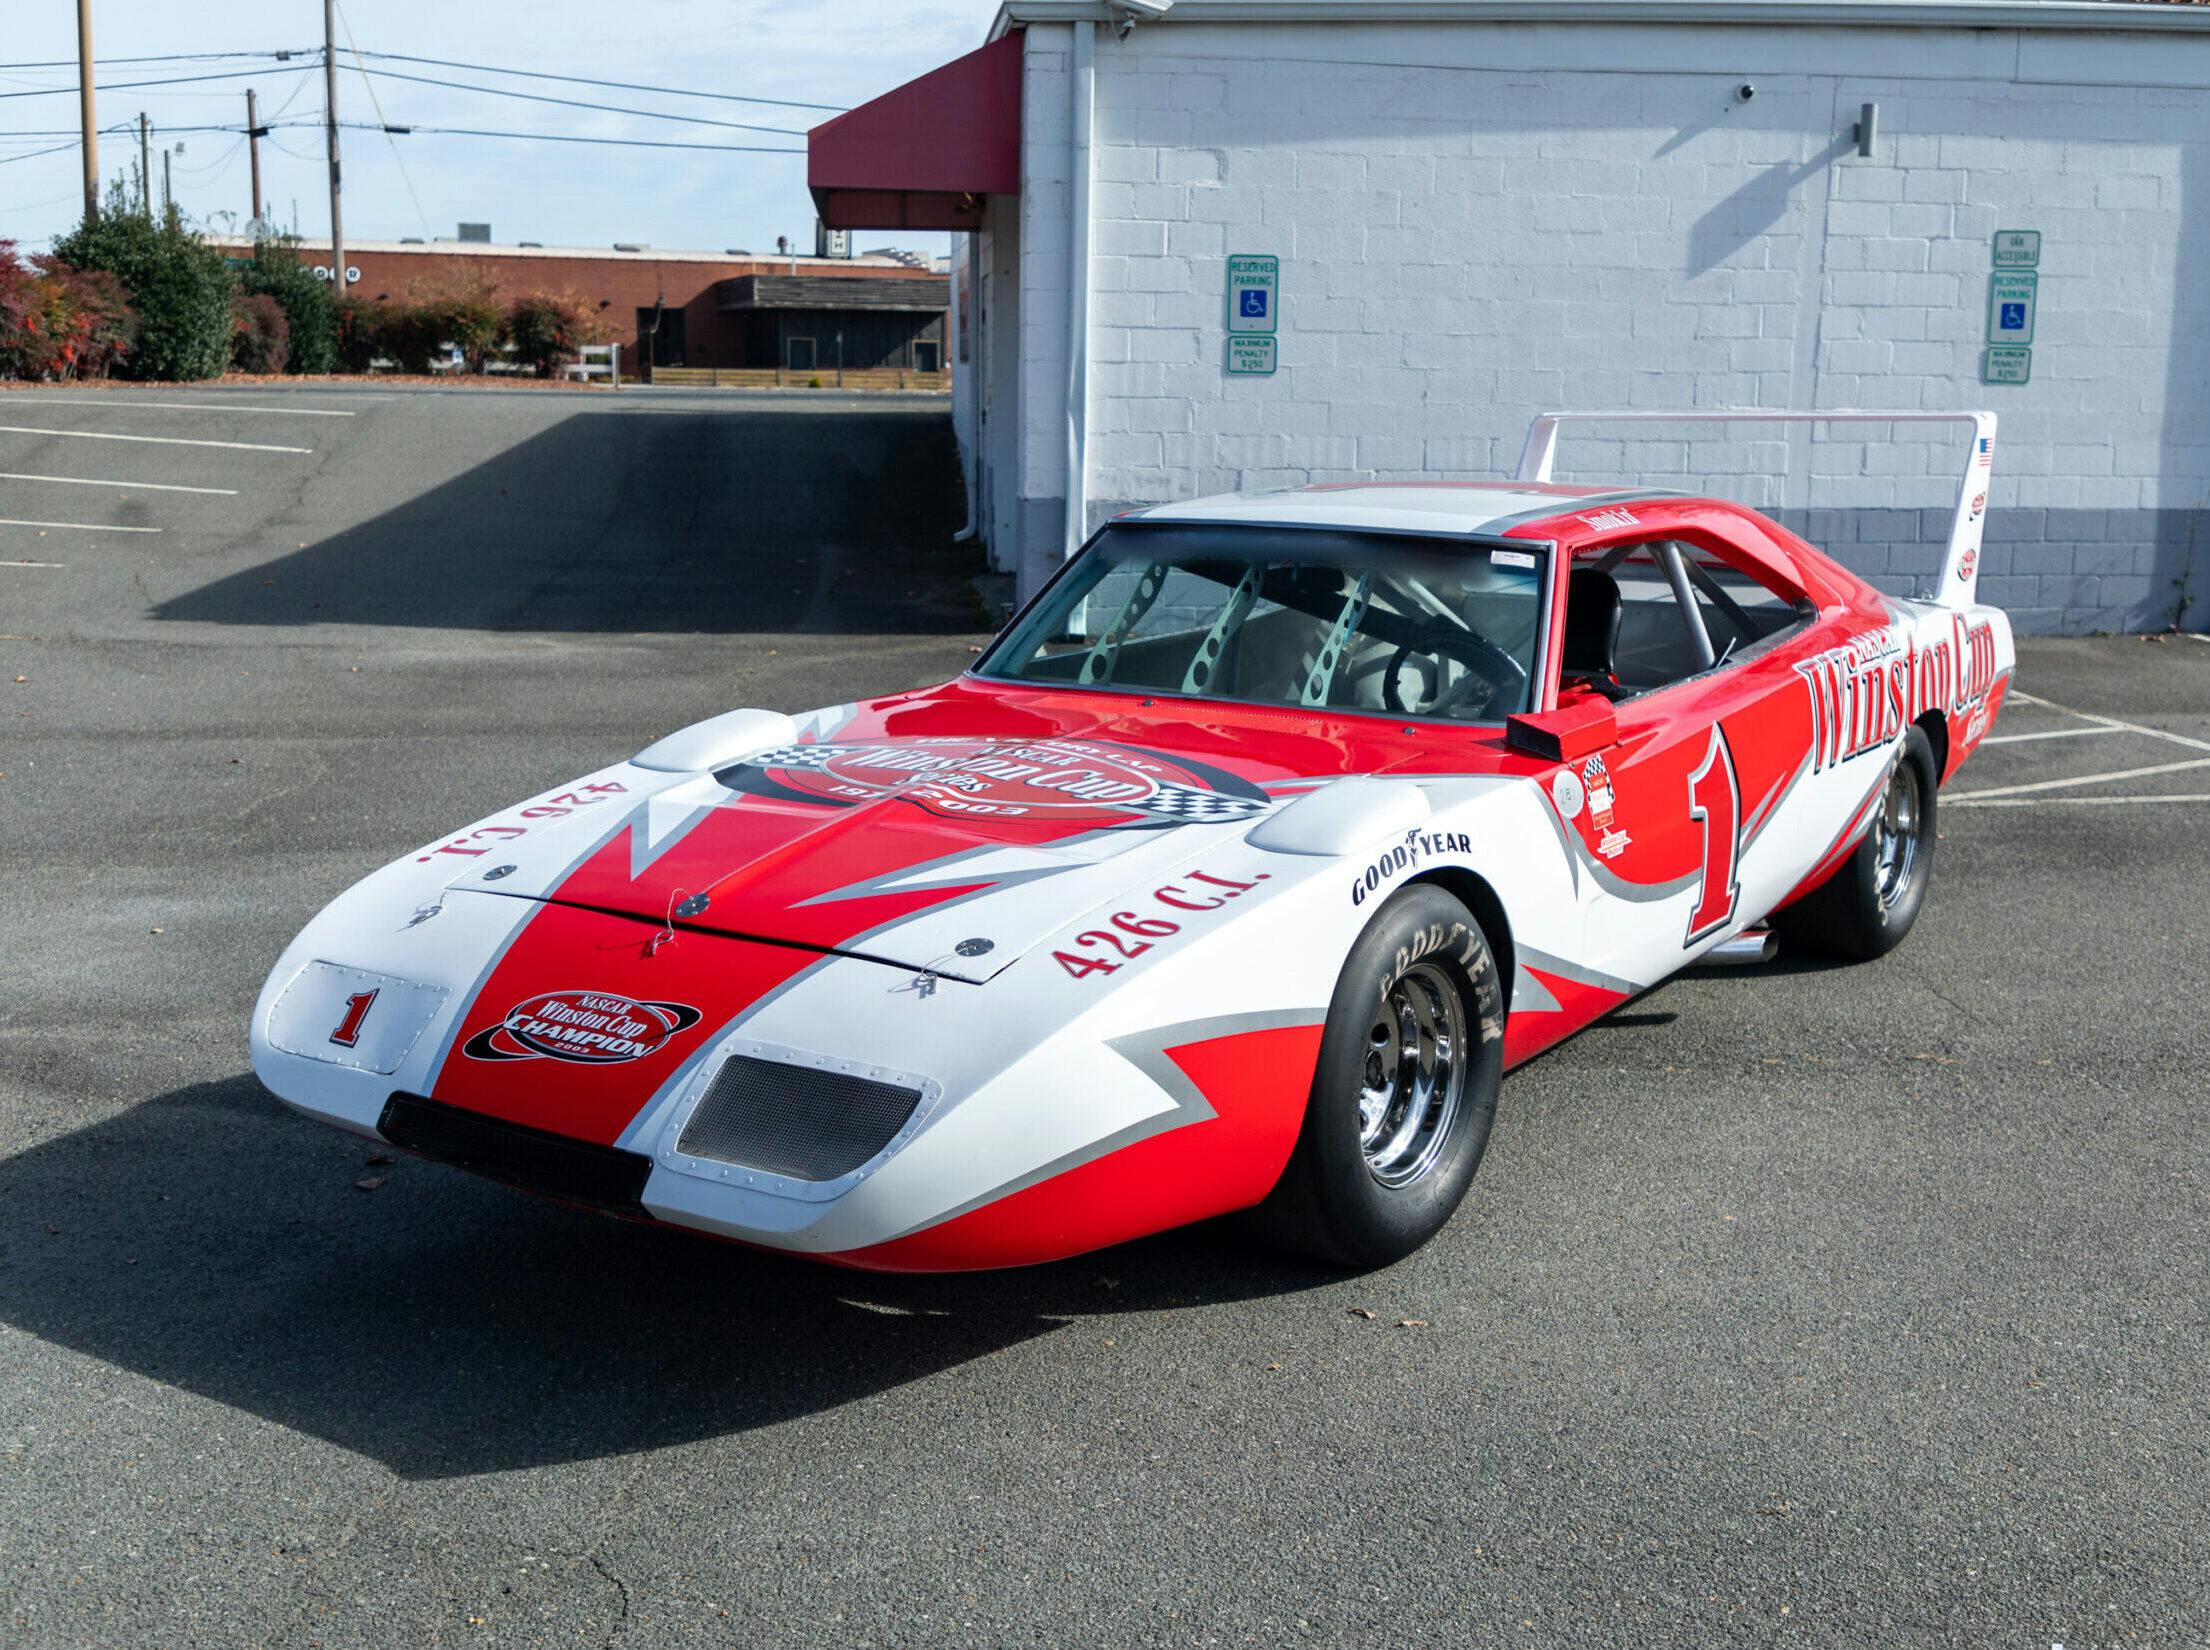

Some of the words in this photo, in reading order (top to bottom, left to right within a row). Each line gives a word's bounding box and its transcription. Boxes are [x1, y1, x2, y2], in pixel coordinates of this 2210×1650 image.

[1231, 262, 1277, 273] RESERVED
[1234, 276, 1272, 286] PARKING
[1997, 289, 2031, 300] PARKING
[1234, 339, 1271, 348] MAXIMUM
[1234, 350, 1269, 358] PENALTY
[1793, 631, 1950, 775] Winston
[1951, 612, 1996, 714] Cup
[842, 749, 1043, 781] Winston
[1023, 769, 1148, 800] Cup
[970, 746, 1083, 767] NASCAR
[520, 782, 629, 818] 426
[1684, 720, 1741, 949] 1
[1051, 911, 1181, 979] 426
[1153, 870, 1272, 911] C.I.
[329, 987, 380, 1048] 1
[534, 1000, 609, 1030] Winston
[604, 1015, 648, 1039] Cup
[576, 995, 634, 1015] NASCAR
[502, 1013, 655, 1058] CHAMPION
